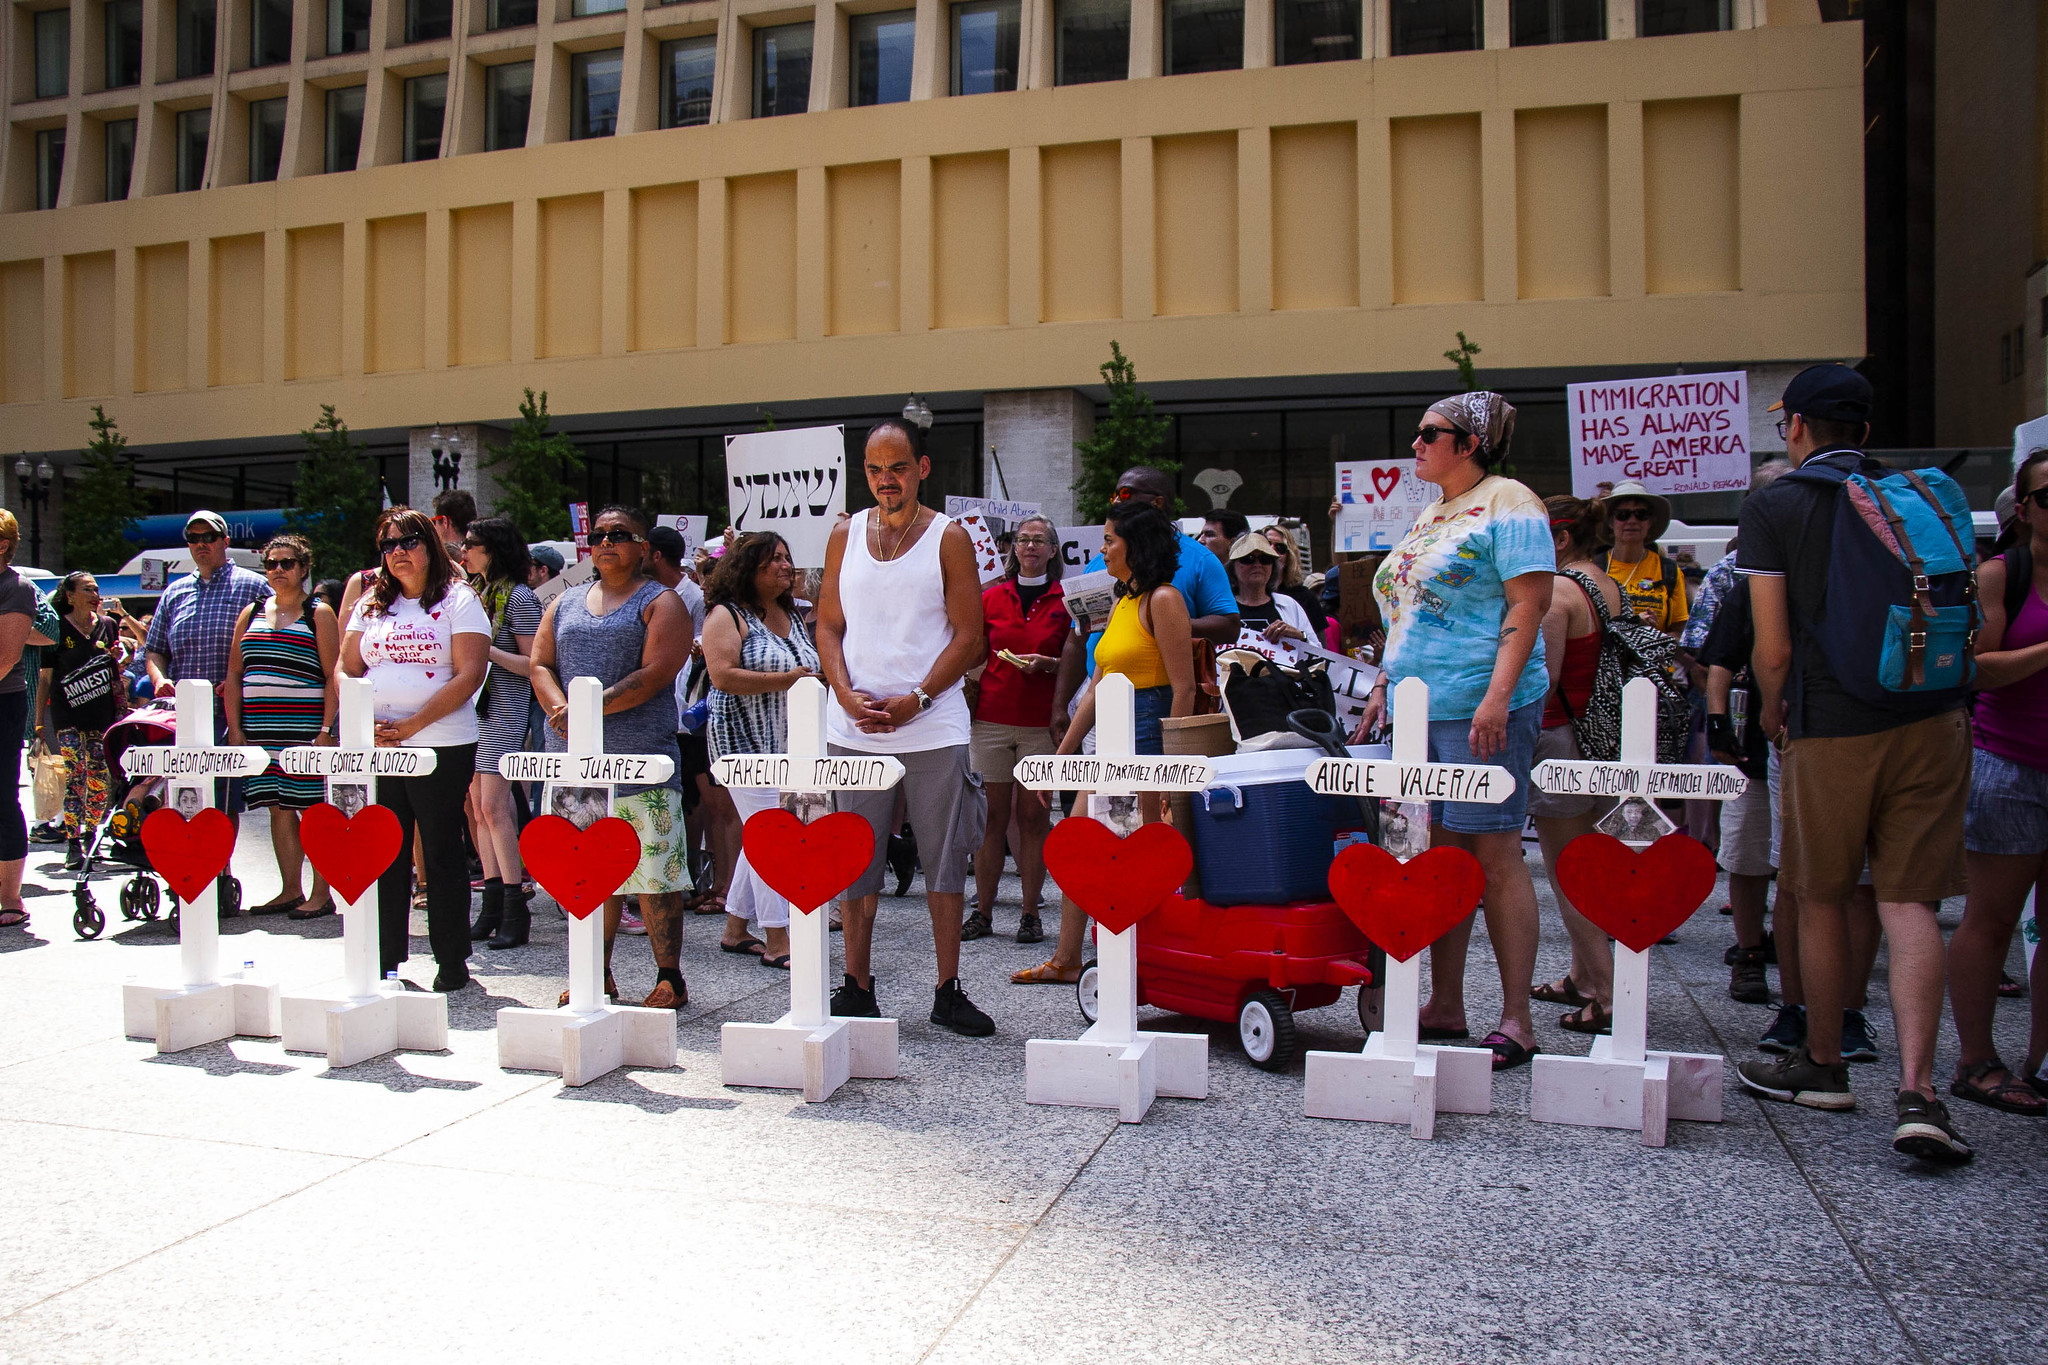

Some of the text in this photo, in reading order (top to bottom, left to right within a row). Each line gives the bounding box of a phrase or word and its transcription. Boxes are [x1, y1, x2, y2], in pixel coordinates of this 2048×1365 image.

[1579, 380, 1740, 414] IMMIGRATION
[1582, 409, 1731, 442] HAS ALWAYS
[1583, 434, 1746, 465] MADE AMERICA
[1624, 458, 1698, 479] GREAT!
[1673, 481, 1711, 492] RONALD
[1712, 476, 1747, 491] REAGAN
[988, 501, 1008, 515] Child
[386, 631, 435, 642] Familias
[126, 749, 155, 775] JUAN
[284, 750, 419, 774] FELIPE GOMEZ ALONZO
[506, 755, 648, 781] MARIEE JUAREZ
[721, 758, 885, 787] JAKELIN MAQUIN
[1021, 760, 1206, 785] OSCAR ALBERTO MARTINEZ RAMIREZ
[1315, 761, 1490, 800] ANGIE VALERIA
[1540, 763, 1582, 792] CARLOS
[1589, 765, 1640, 795] GREGORIO
[1646, 769, 1703, 795] HERNANDEZ
